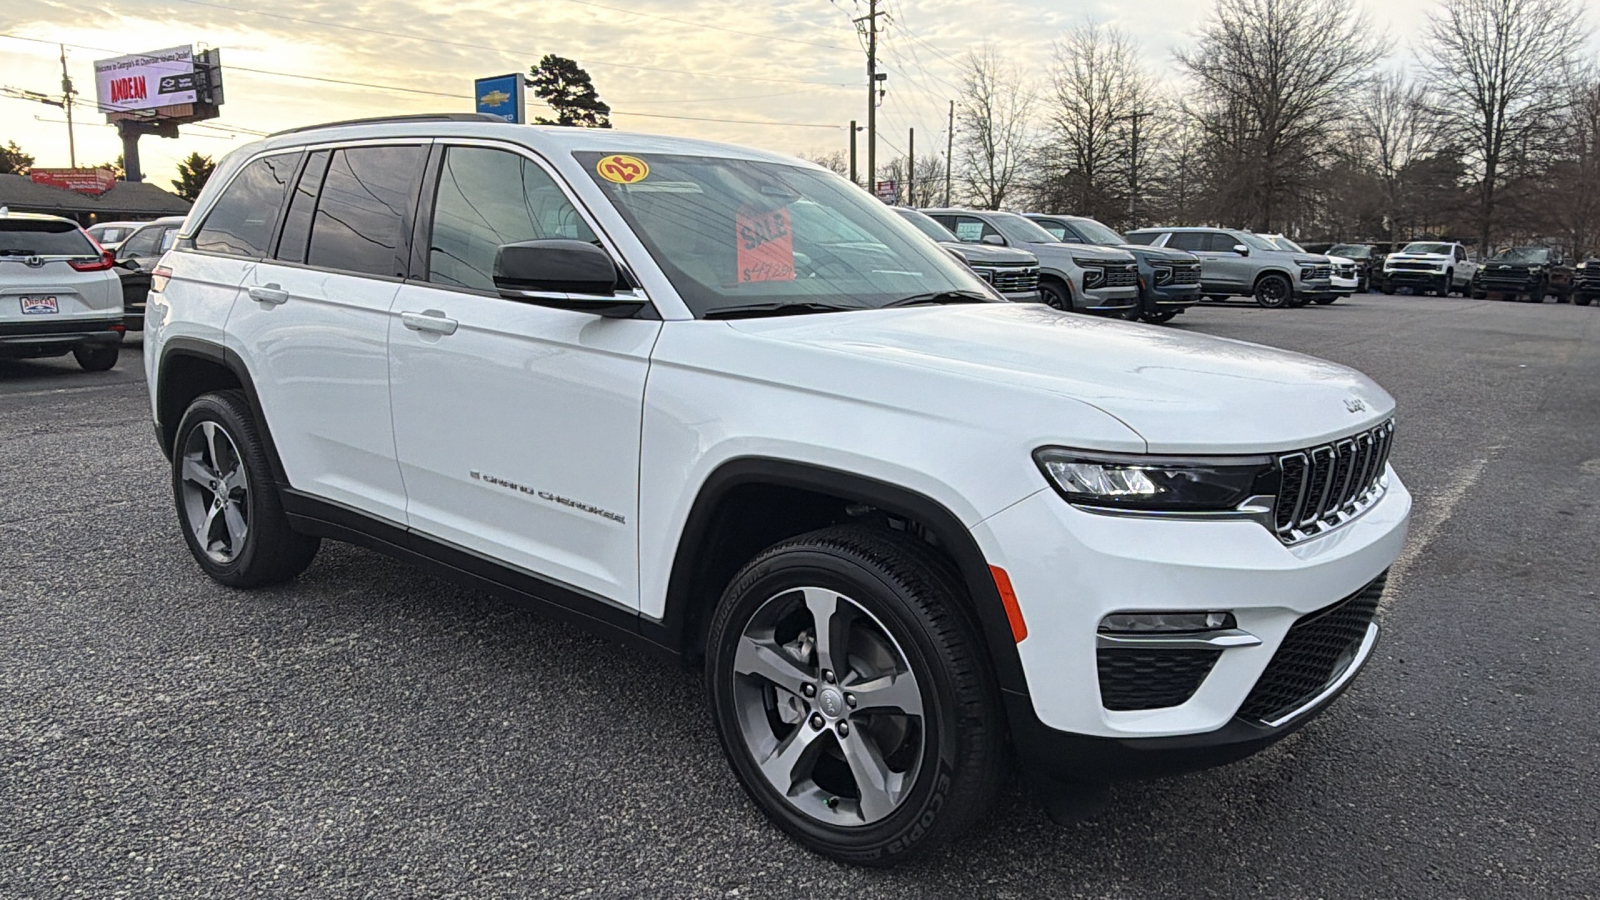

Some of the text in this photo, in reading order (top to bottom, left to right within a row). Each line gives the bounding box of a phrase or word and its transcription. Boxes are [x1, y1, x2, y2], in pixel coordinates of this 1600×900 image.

[110, 75, 147, 103] ANDEAN
[606, 156, 641, 182] 25
[741, 213, 787, 250] SALE
[482, 474, 626, 524] GRAND CHEROKEE
